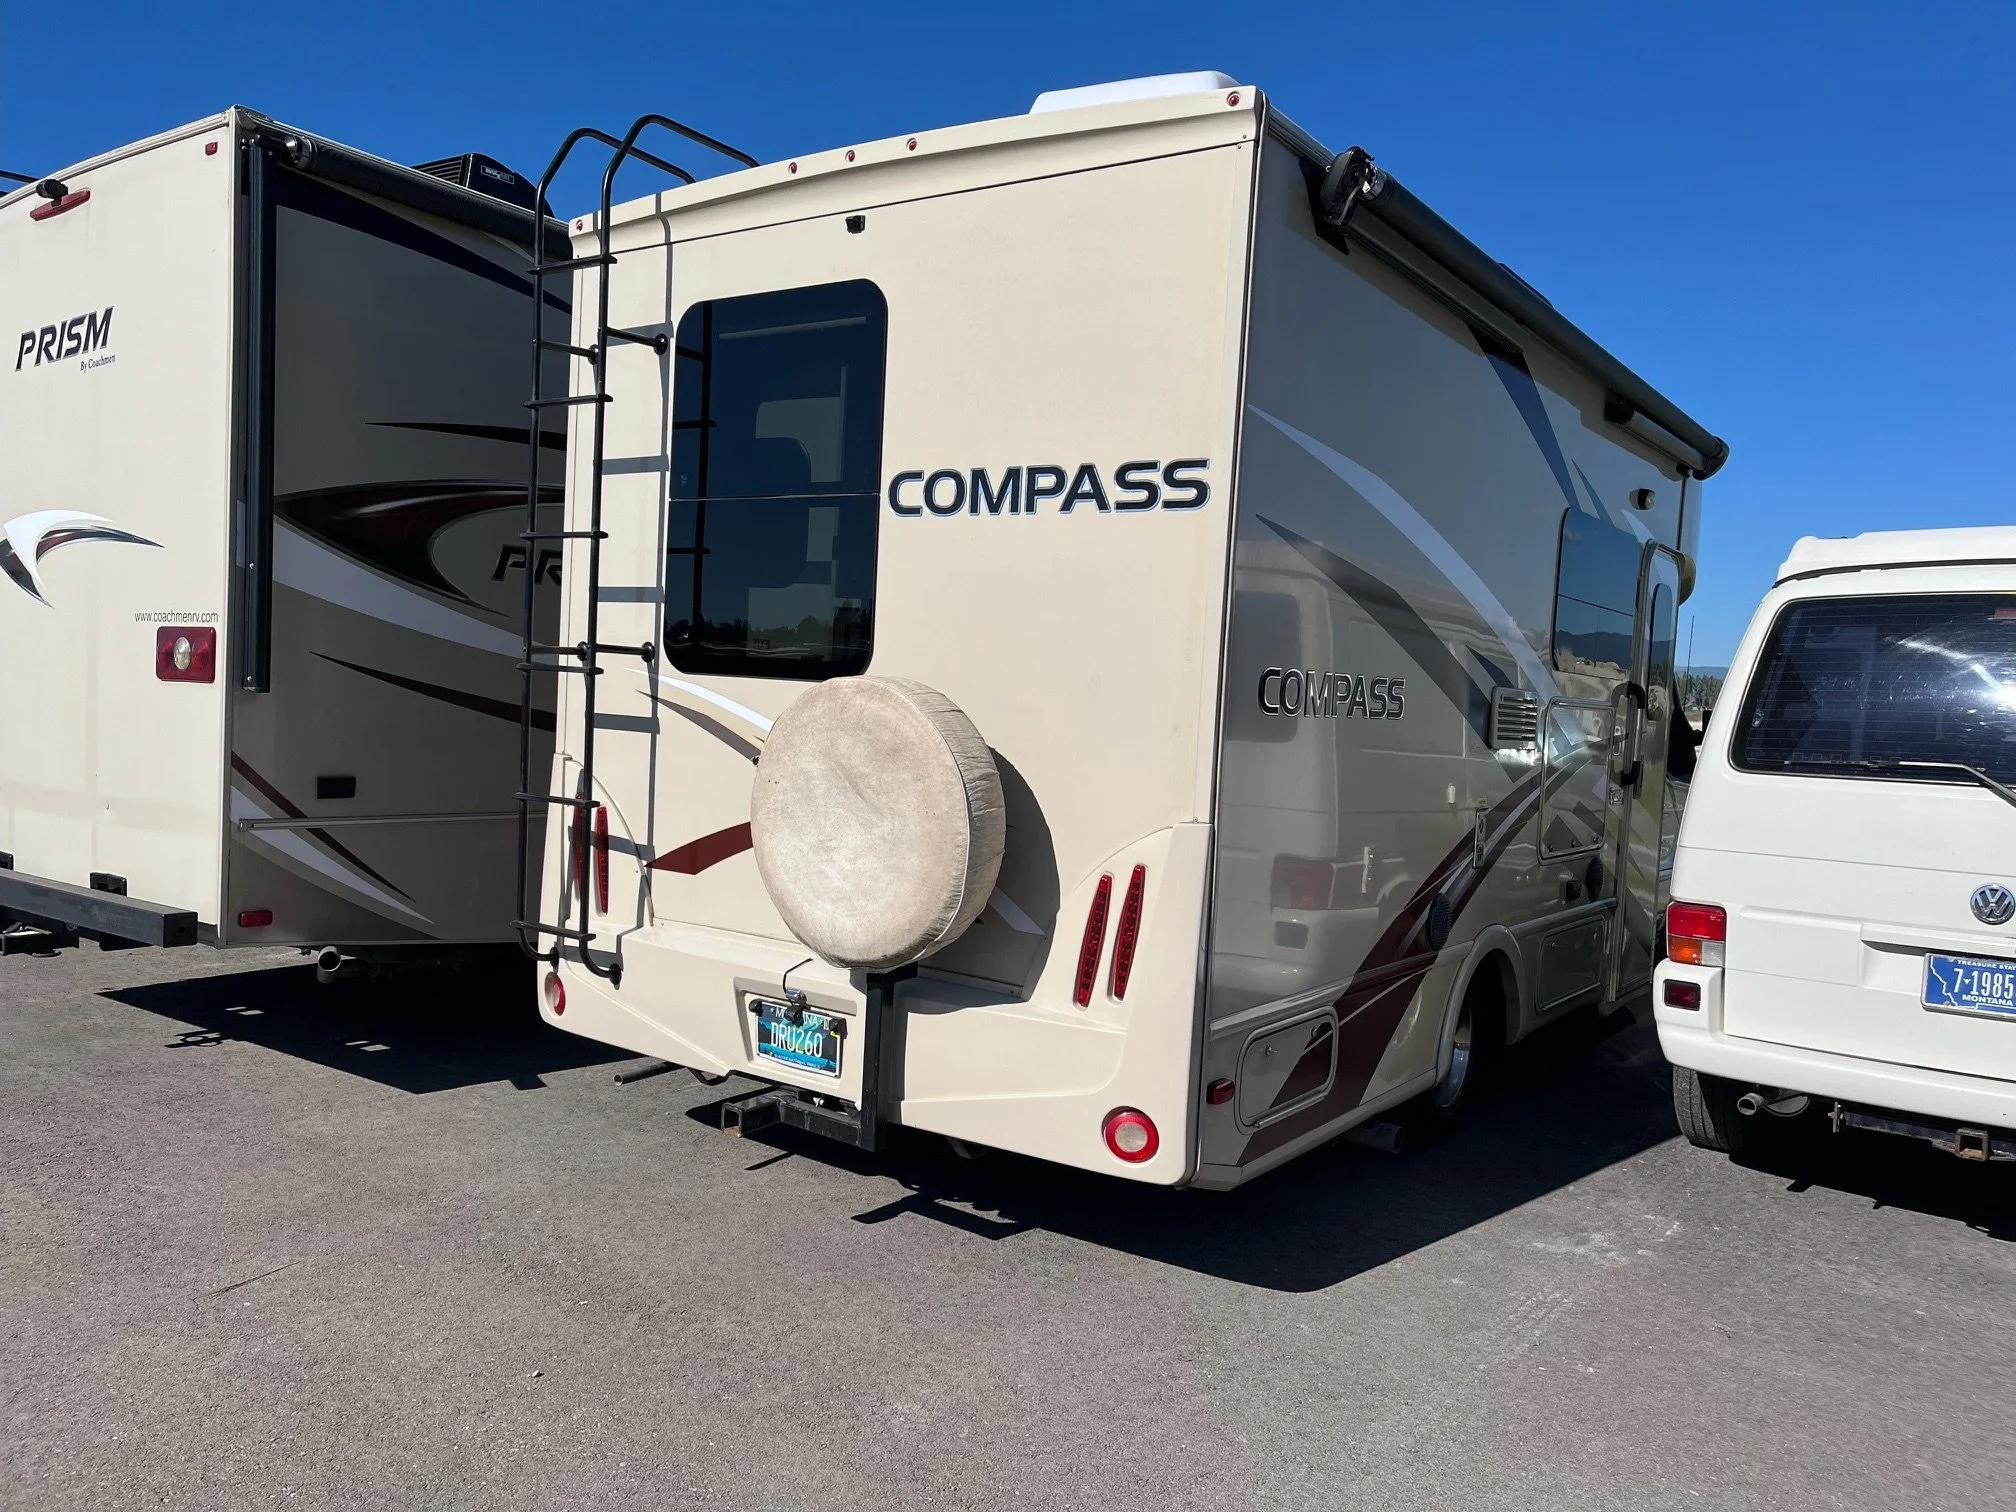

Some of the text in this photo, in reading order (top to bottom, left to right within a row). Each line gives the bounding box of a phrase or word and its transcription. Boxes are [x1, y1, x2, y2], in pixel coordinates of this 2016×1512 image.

[15, 305, 114, 371] PRISM
[80, 355, 116, 373] By Coachmen
[887, 457, 1212, 517] COMPASS
[134, 610, 219, 623] www.coachmenrv.com
[1257, 665, 1406, 720] COMPASS
[1957, 959, 1997, 969] TREASURE
[1962, 994, 2014, 1007] MONTANA
[770, 1021, 823, 1058] DRU260
